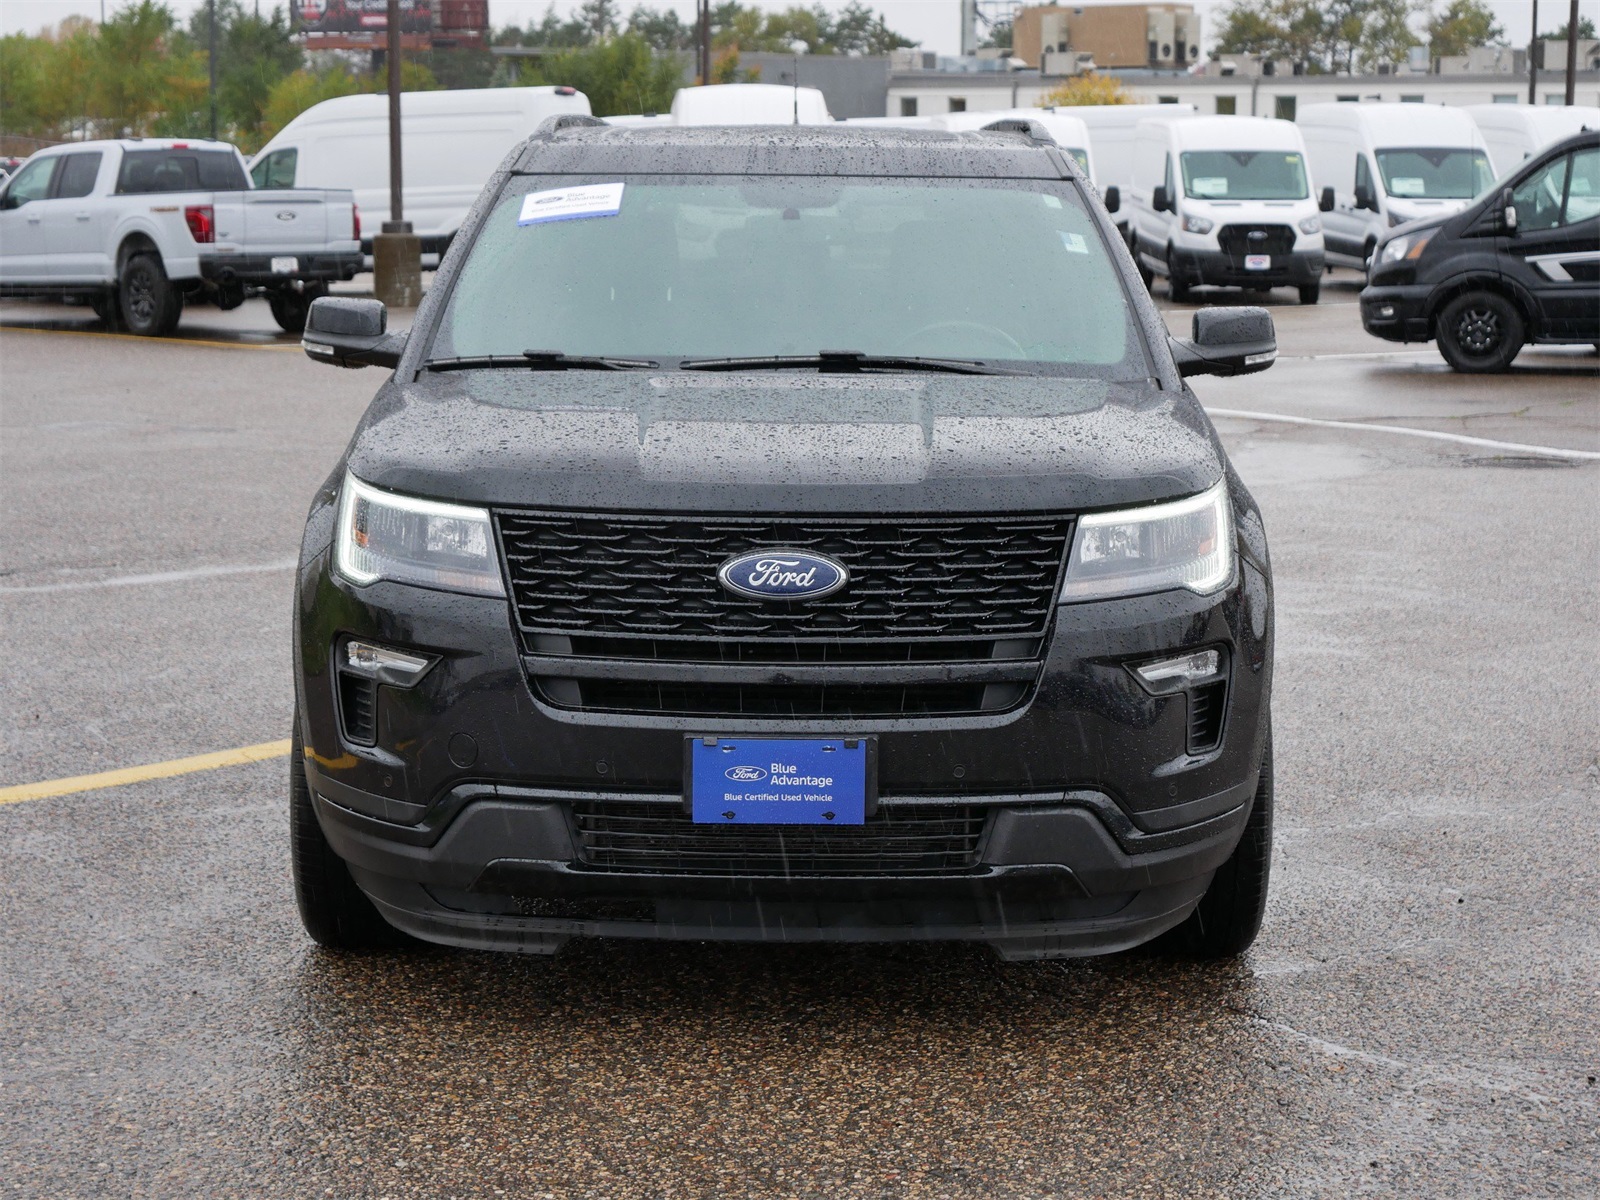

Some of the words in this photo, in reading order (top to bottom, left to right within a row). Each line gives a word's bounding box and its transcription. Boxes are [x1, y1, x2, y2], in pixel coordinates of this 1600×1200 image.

[749, 559, 817, 587] Ford
[733, 767, 760, 779] Ford
[770, 763, 797, 774] Blue
[770, 775, 833, 788] Advantage
[724, 793, 743, 801] Blue
[744, 793, 779, 801] Certified
[781, 793, 802, 802] Used
[803, 794, 833, 802] Vehicle
